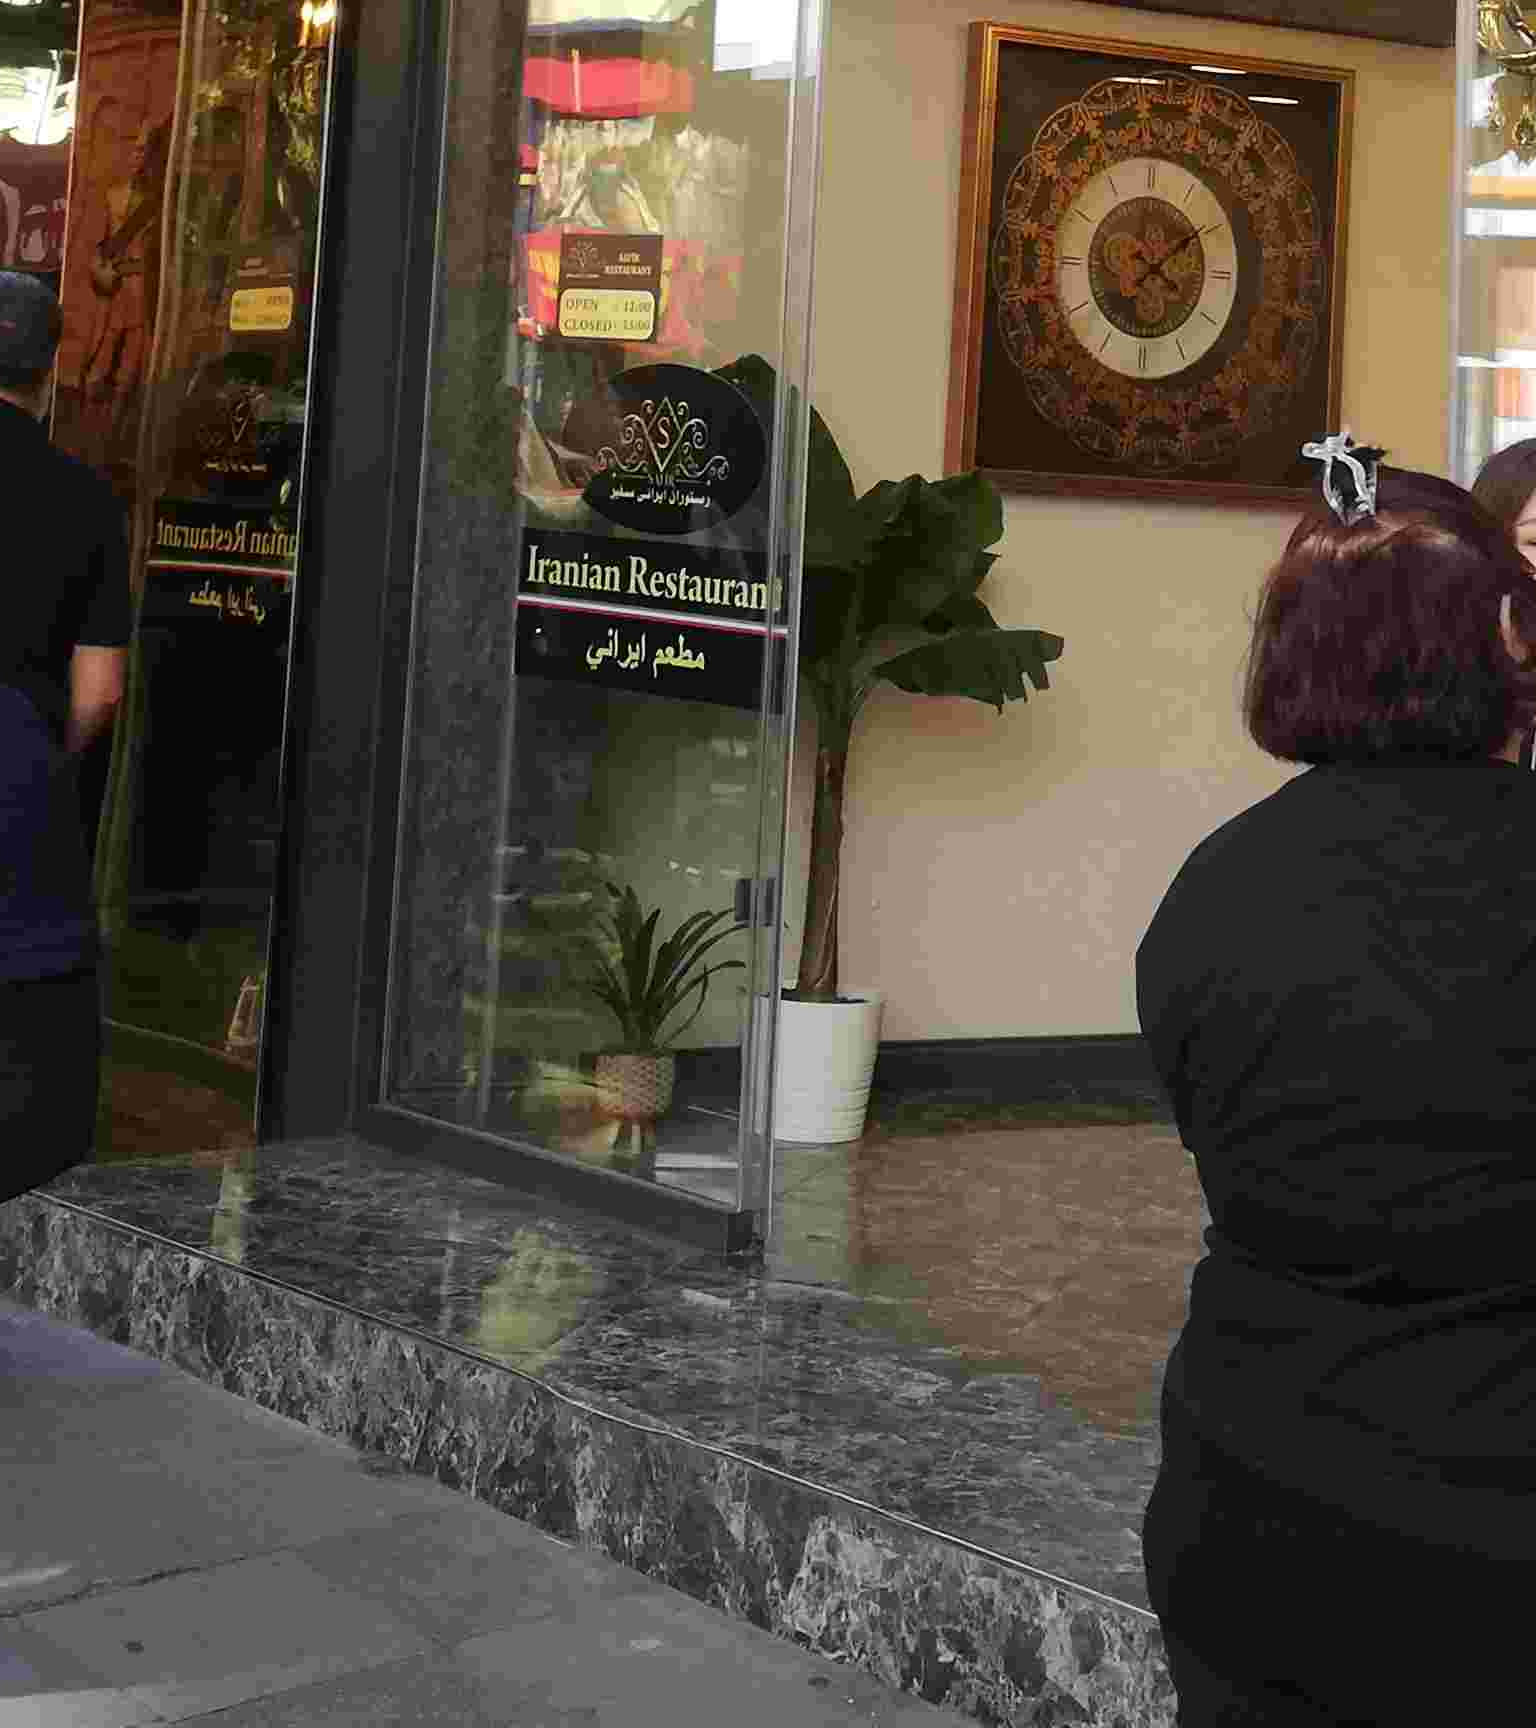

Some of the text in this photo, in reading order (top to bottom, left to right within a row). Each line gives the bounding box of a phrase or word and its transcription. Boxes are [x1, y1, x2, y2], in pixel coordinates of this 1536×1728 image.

[565, 297, 600, 313] OPEN
[527, 544, 621, 593] Iranian
[652, 632, 706, 679] مطعم
